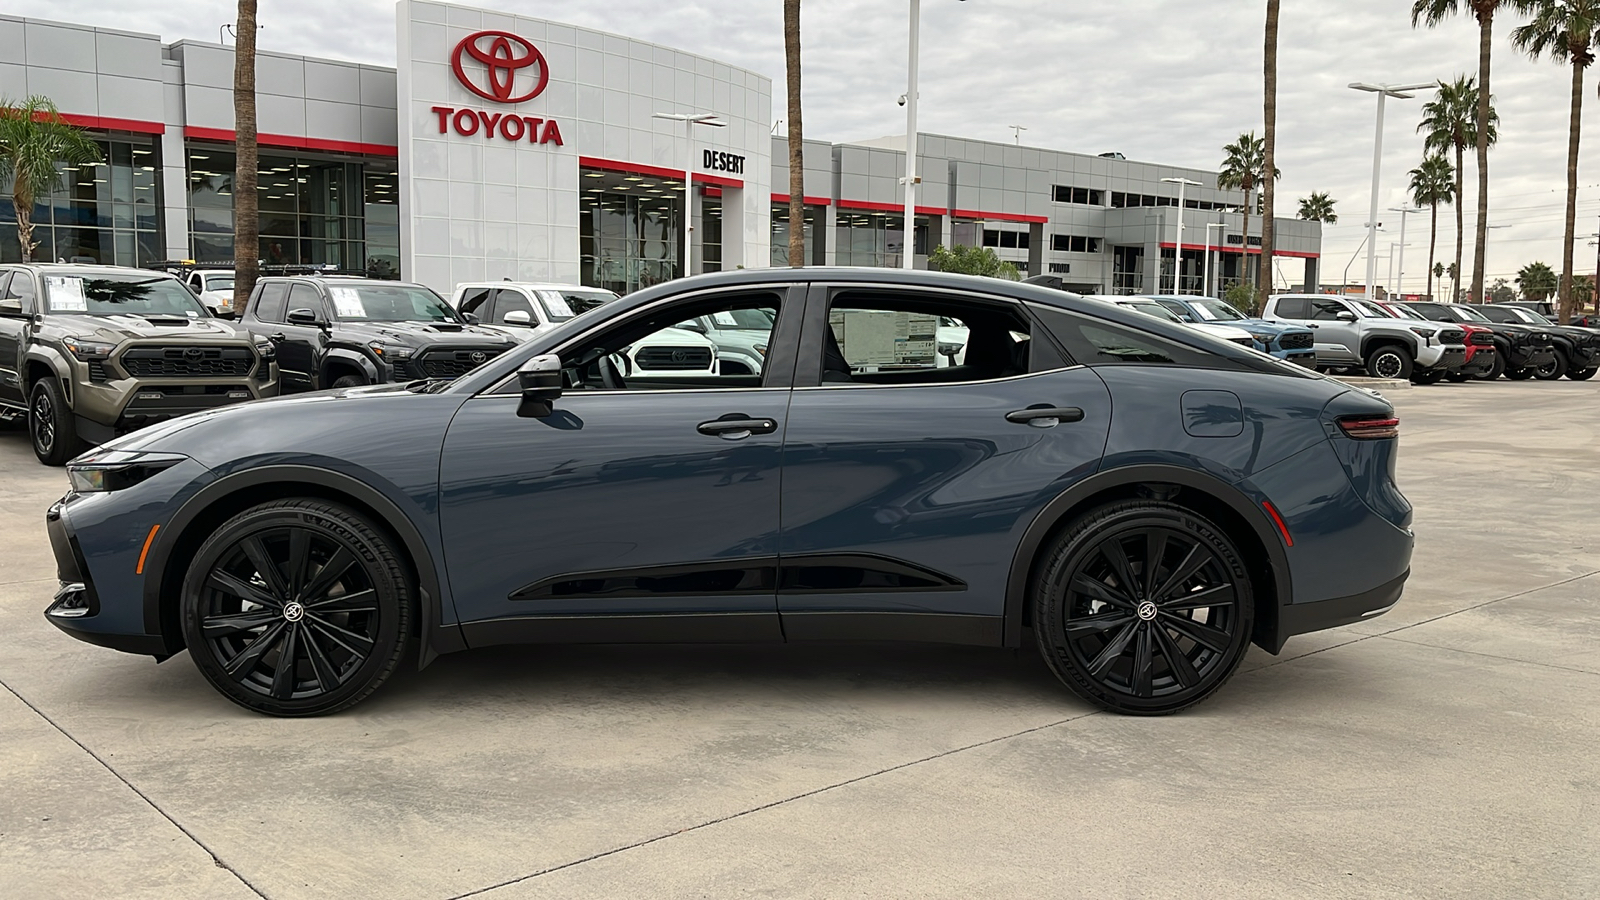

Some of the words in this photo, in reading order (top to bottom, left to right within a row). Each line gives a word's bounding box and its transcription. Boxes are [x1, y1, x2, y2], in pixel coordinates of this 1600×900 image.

[431, 106, 564, 146] TOYOTA
[703, 149, 745, 174] DESERT
[319, 519, 373, 560] MICHELIN
[1200, 528, 1244, 577] MICHELIN
